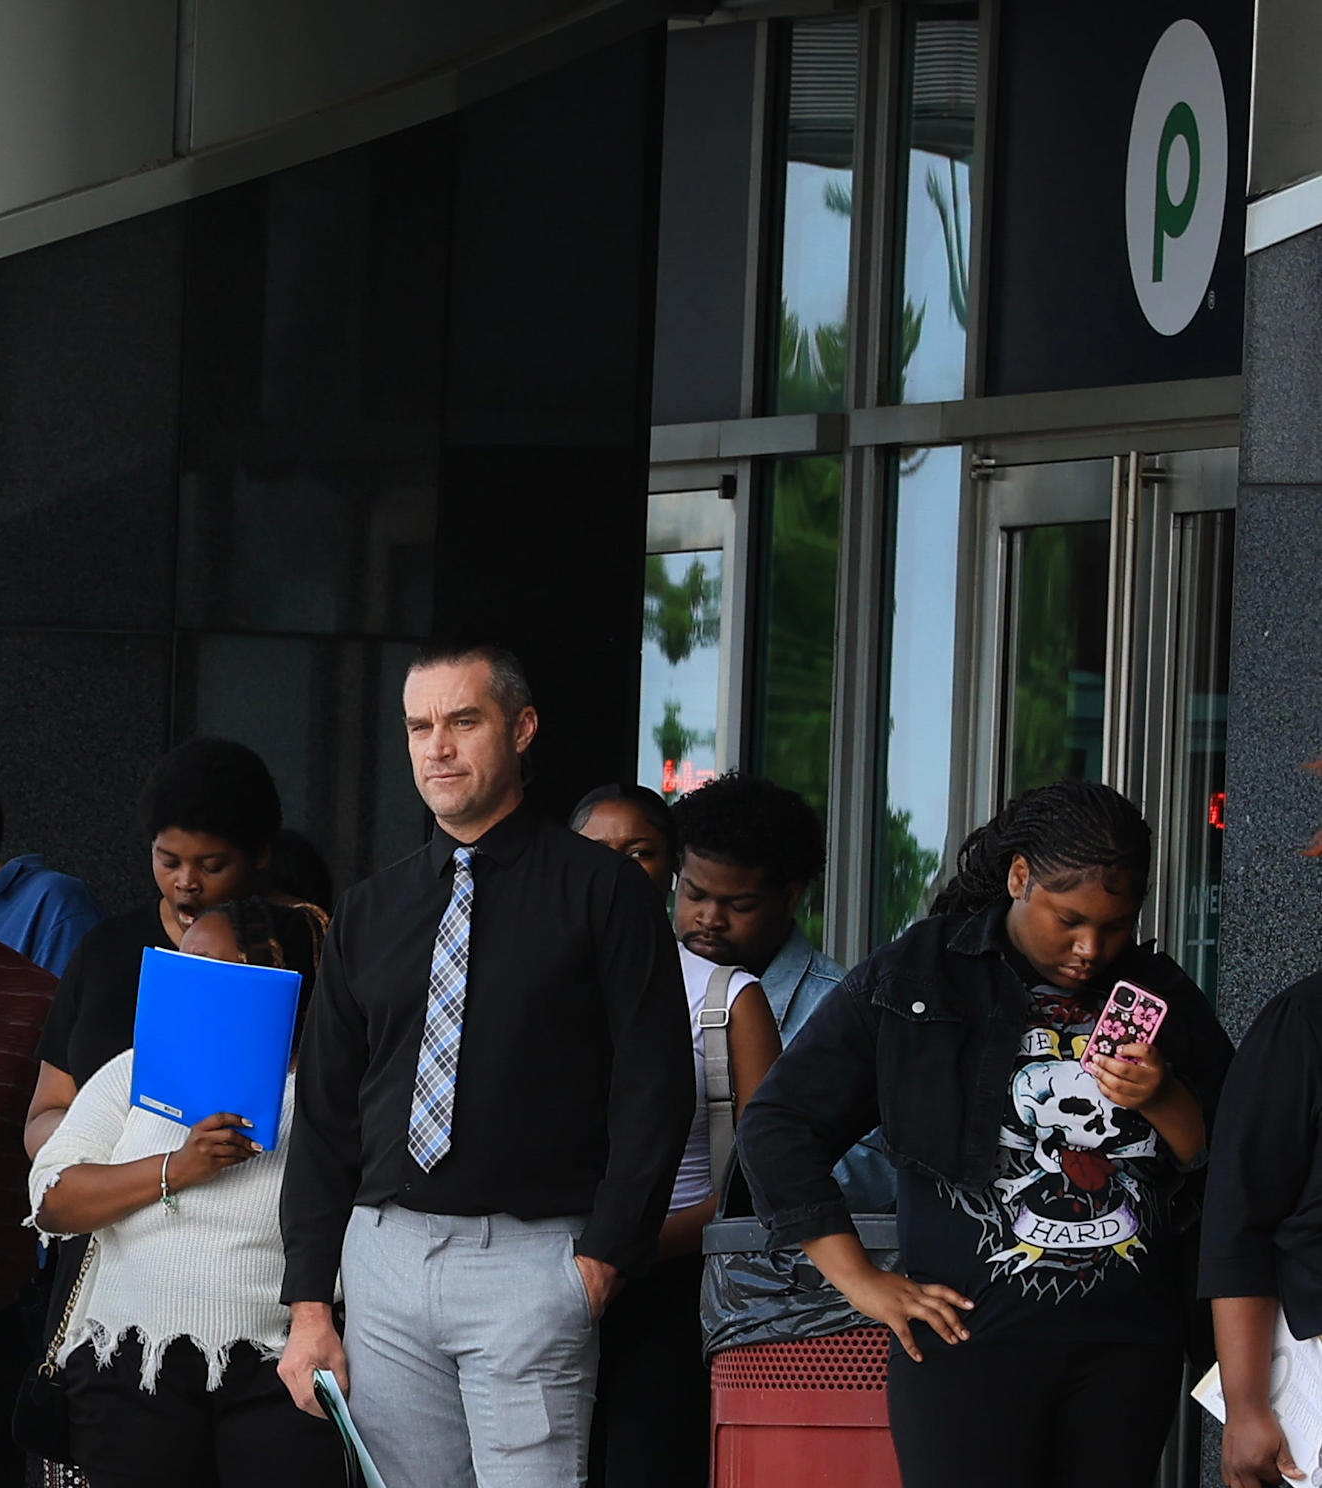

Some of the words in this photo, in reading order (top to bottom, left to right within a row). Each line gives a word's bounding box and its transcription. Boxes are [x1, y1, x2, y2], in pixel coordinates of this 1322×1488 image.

[1188, 885, 1223, 914] AME
[1020, 1032, 1054, 1054] VE
[1026, 1219, 1120, 1243] HARD
